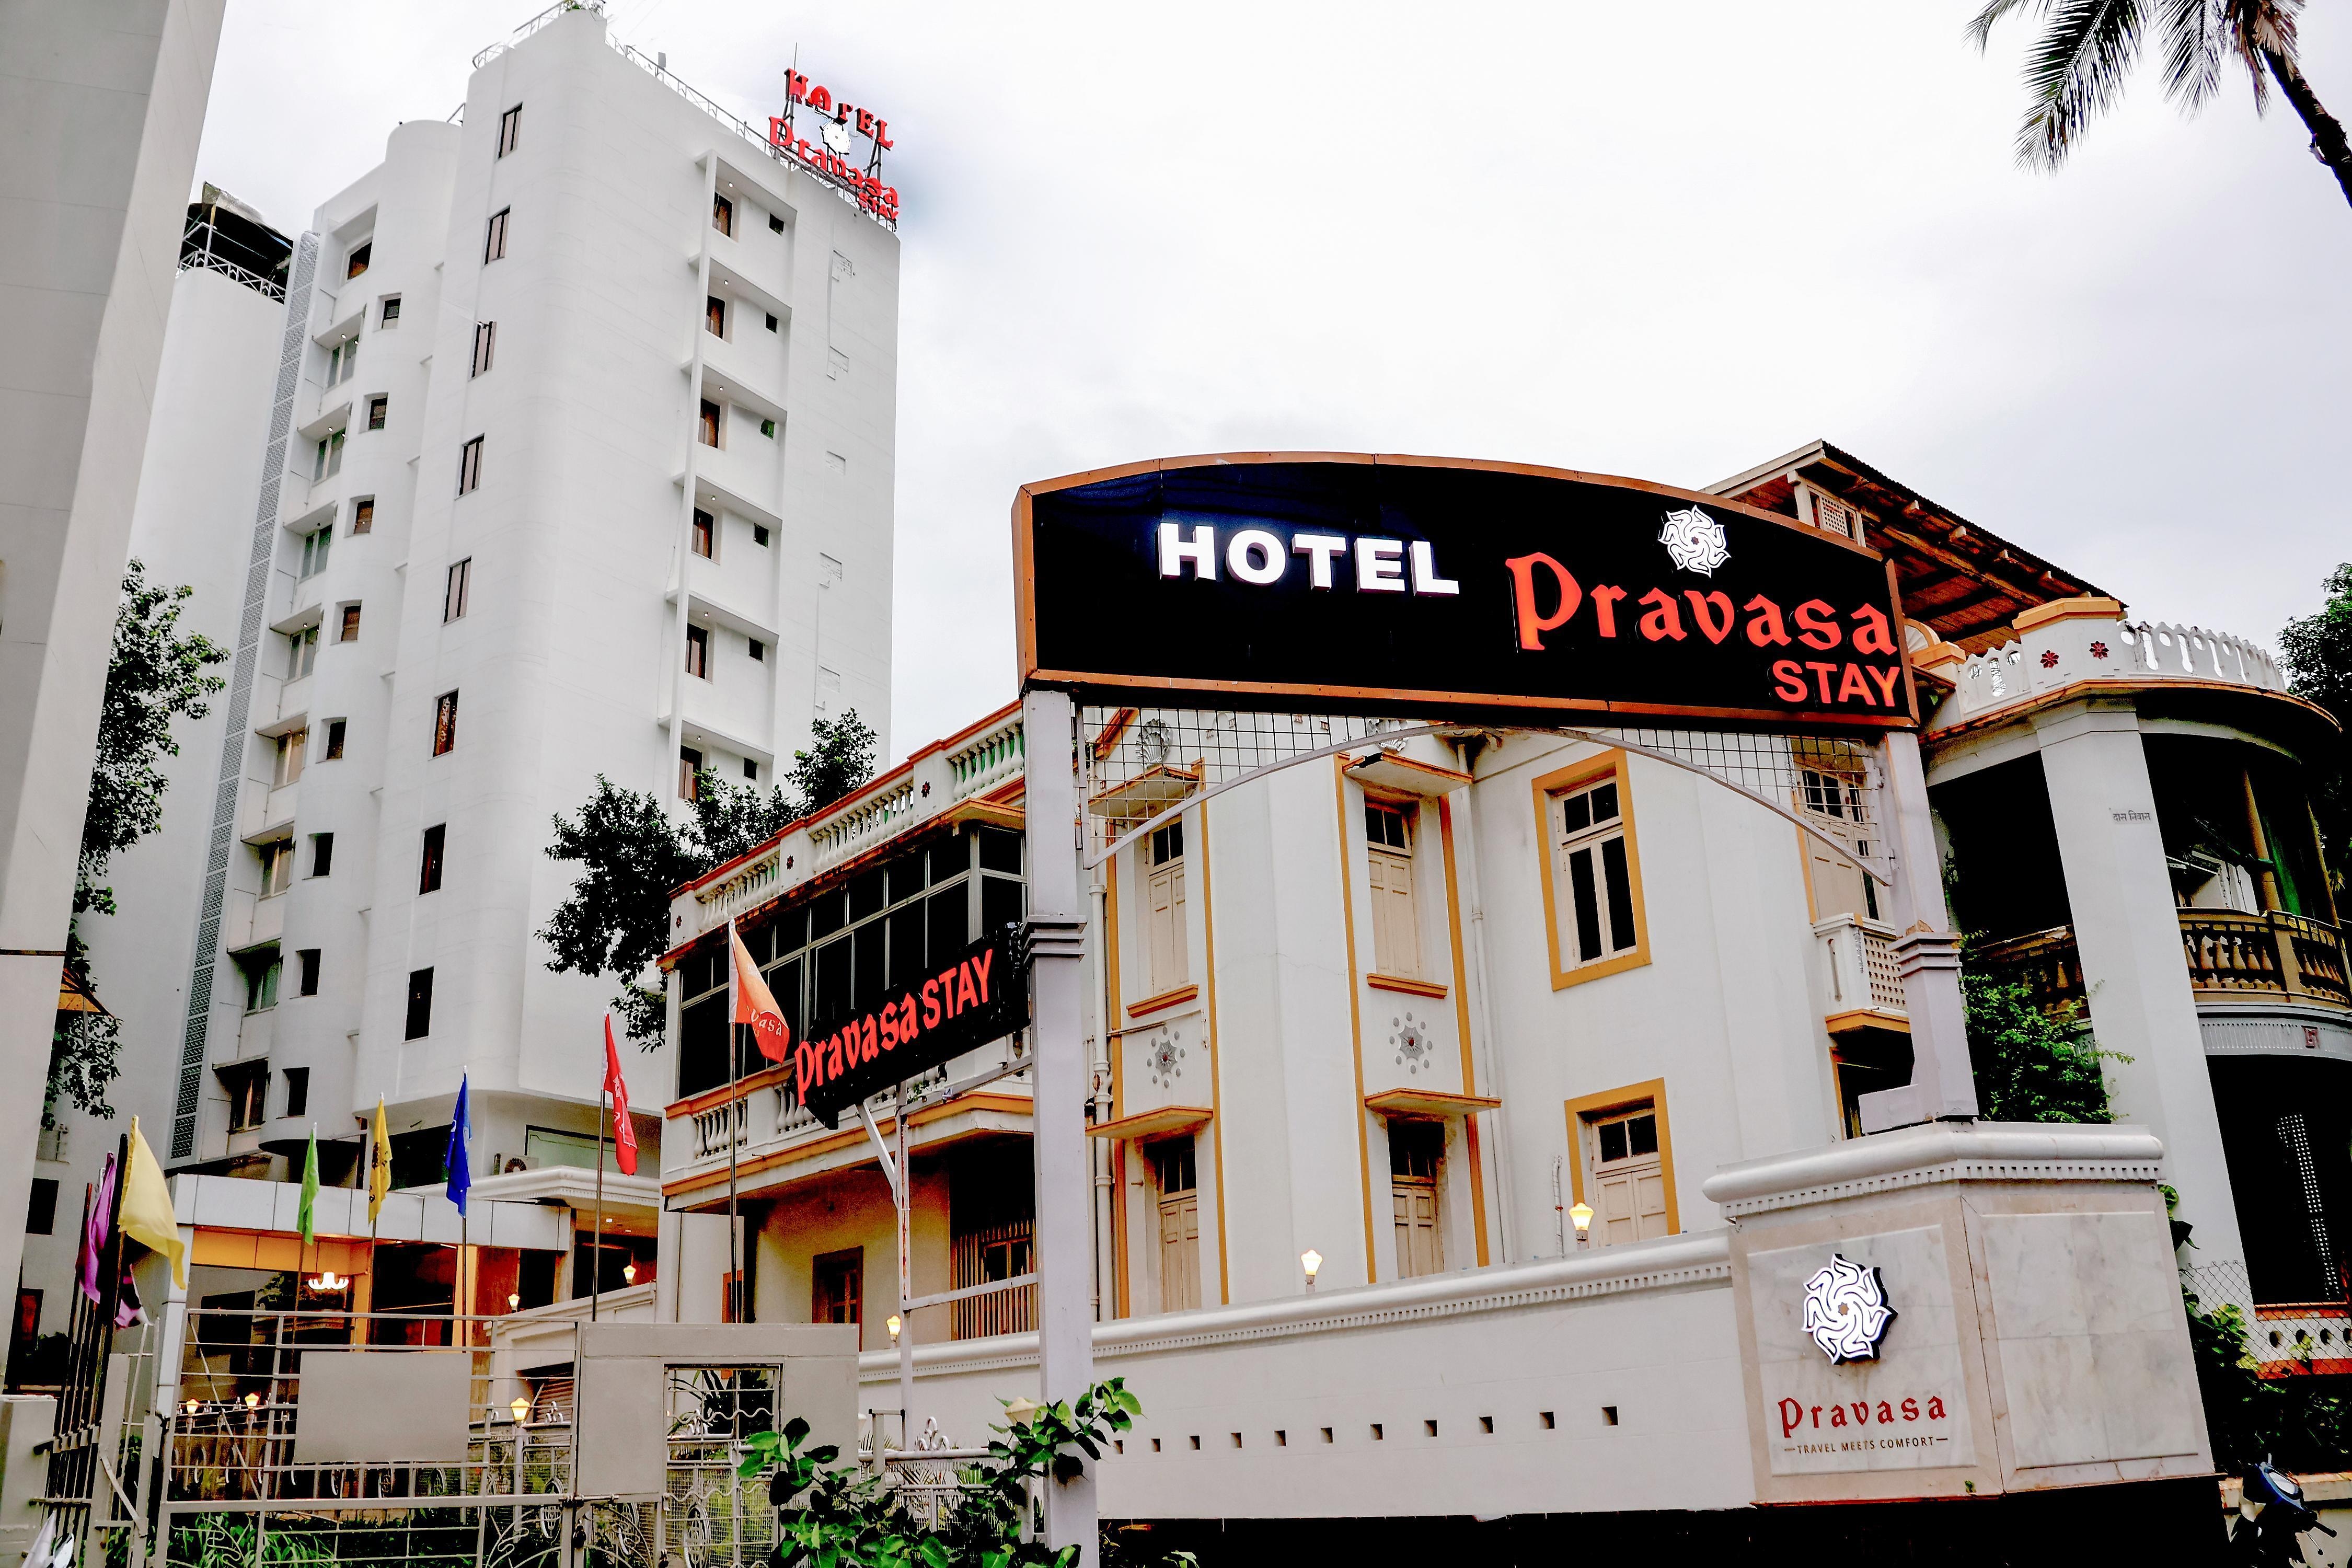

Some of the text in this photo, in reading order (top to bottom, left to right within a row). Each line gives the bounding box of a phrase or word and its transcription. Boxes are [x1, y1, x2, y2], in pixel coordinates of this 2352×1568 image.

[1158, 522, 1897, 655] HOTEL Pravasa
[1772, 660, 1900, 707] STAY
[794, 949, 993, 1106] Pravasa STAY
[1778, 1396, 1946, 1438] Pravasa
[1797, 1436, 1933, 1455] TRAVEL MEETS COMFORT
